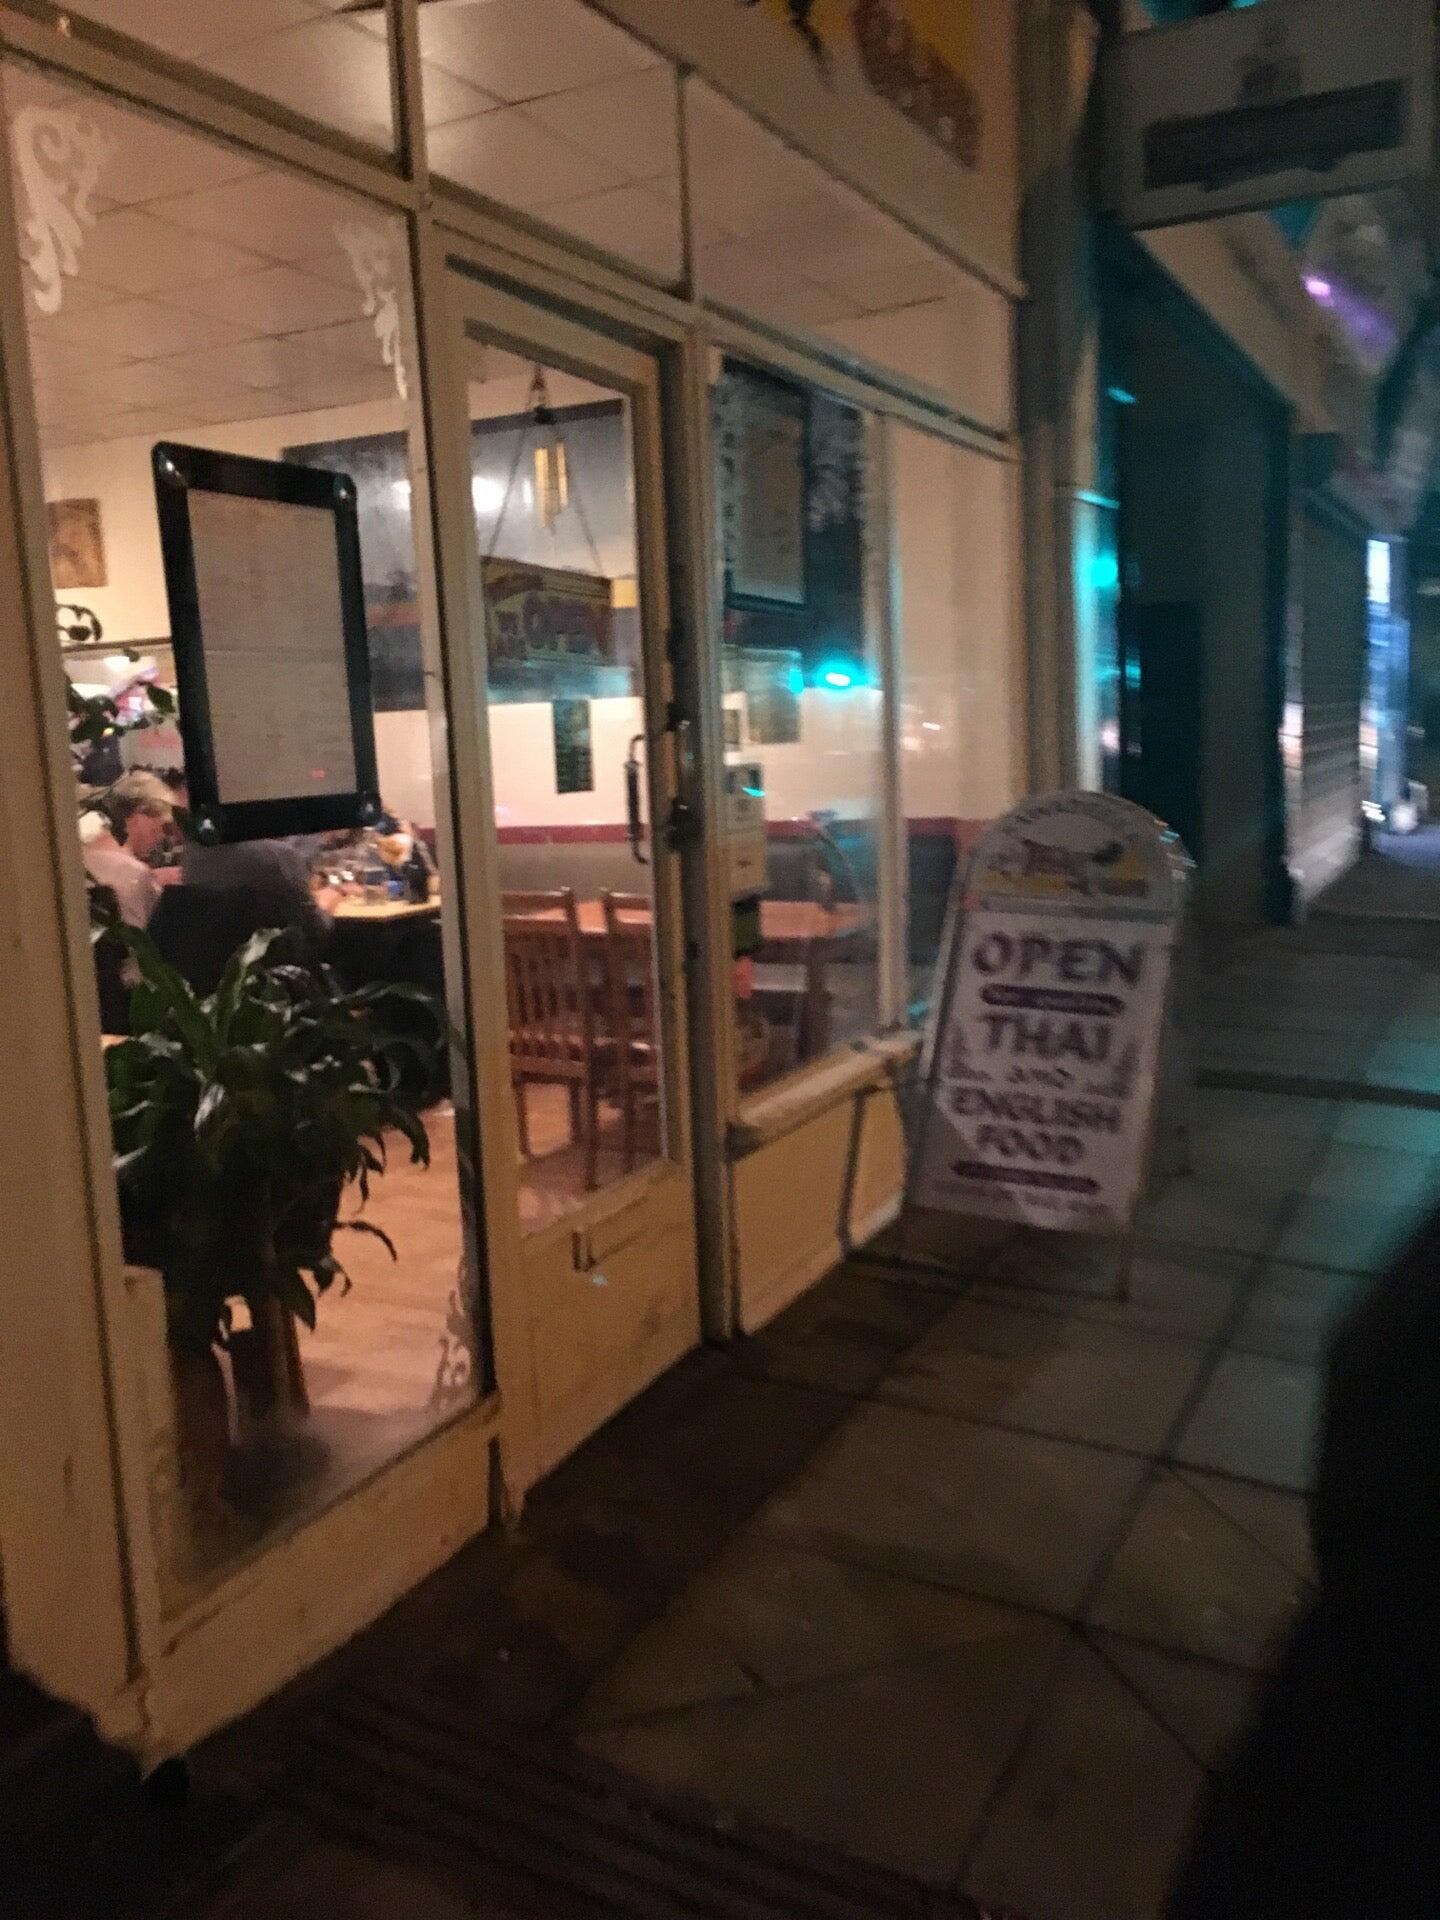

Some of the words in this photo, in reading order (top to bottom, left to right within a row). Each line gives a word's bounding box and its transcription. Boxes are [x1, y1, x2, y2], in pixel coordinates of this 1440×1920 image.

[971, 931, 1143, 987] OPEN
[976, 1012, 1113, 1062] THAI
[952, 1086, 1122, 1134] ENGLISH
[976, 1124, 1086, 1166] FOOD
